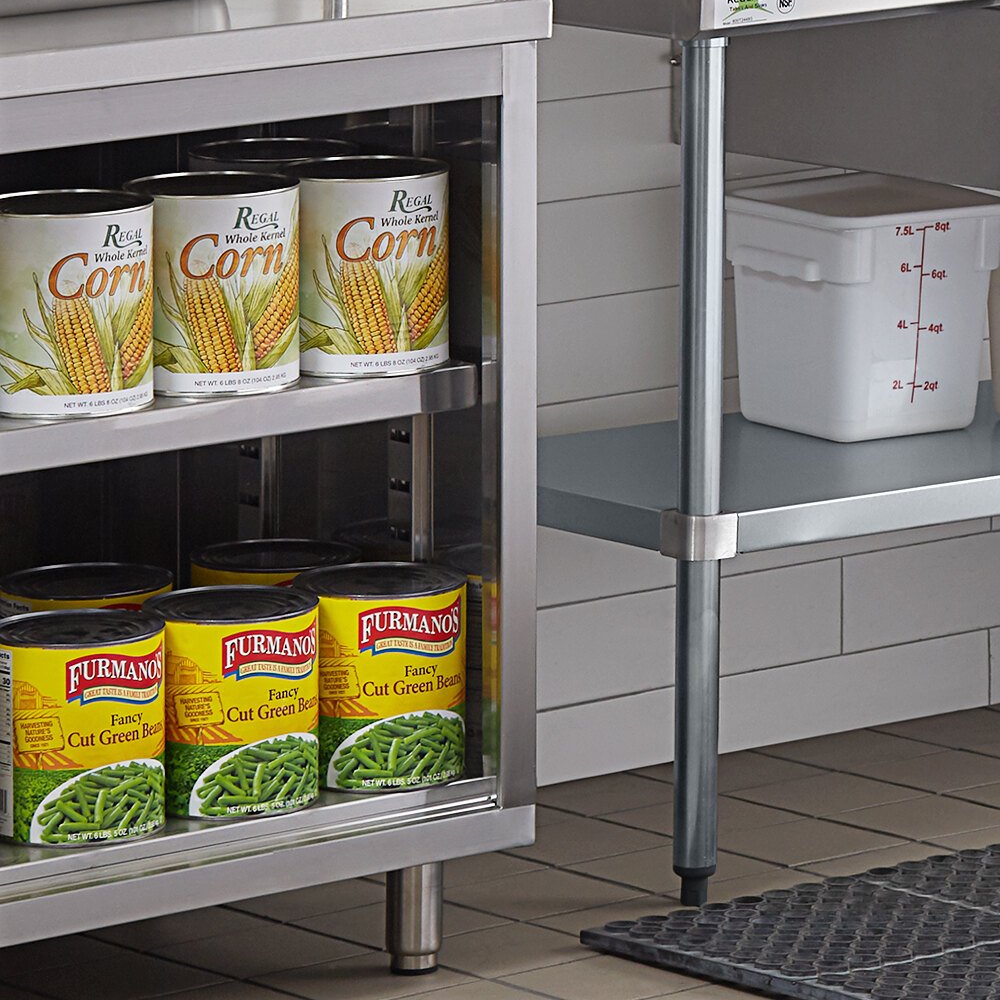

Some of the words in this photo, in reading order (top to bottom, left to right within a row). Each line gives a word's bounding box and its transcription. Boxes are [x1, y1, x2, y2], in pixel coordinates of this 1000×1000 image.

[389, 189, 432, 214] REGAL
[233, 206, 280, 231] REGAL
[381, 217, 412, 227] Whole
[414, 211, 439, 224] Kernel
[102, 224, 142, 248] REGAL
[225, 233, 258, 244] Whole
[260, 228, 286, 242] Kernel
[336, 217, 436, 262] Corn
[895, 226, 914, 236] 7.5L
[94, 252, 125, 263] Whole
[126, 245, 148, 259] Kernel
[180, 234, 284, 280] Corn
[48, 252, 146, 300] Corn
[900, 263, 912, 272] 6L
[897, 320, 908, 329] 4L
[892, 380, 903, 390] 2L
[361, 607, 459, 643] FURMANO'S
[224, 628, 316, 669] FURMANO'S
[68, 651, 162, 694] FURMANO'S
[404, 665, 438, 677] Fancy
[362, 681, 389, 696] Cut
[393, 680, 433, 695] Green
[437, 673, 462, 690] Beans
[268, 687, 299, 701] Fancy
[111, 712, 143, 726] Fancy
[226, 706, 254, 722] Cut
[257, 704, 296, 720] Green
[67, 731, 96, 748] Cut
[99, 730, 139, 745] Green
[67, 833, 80, 841] NET
